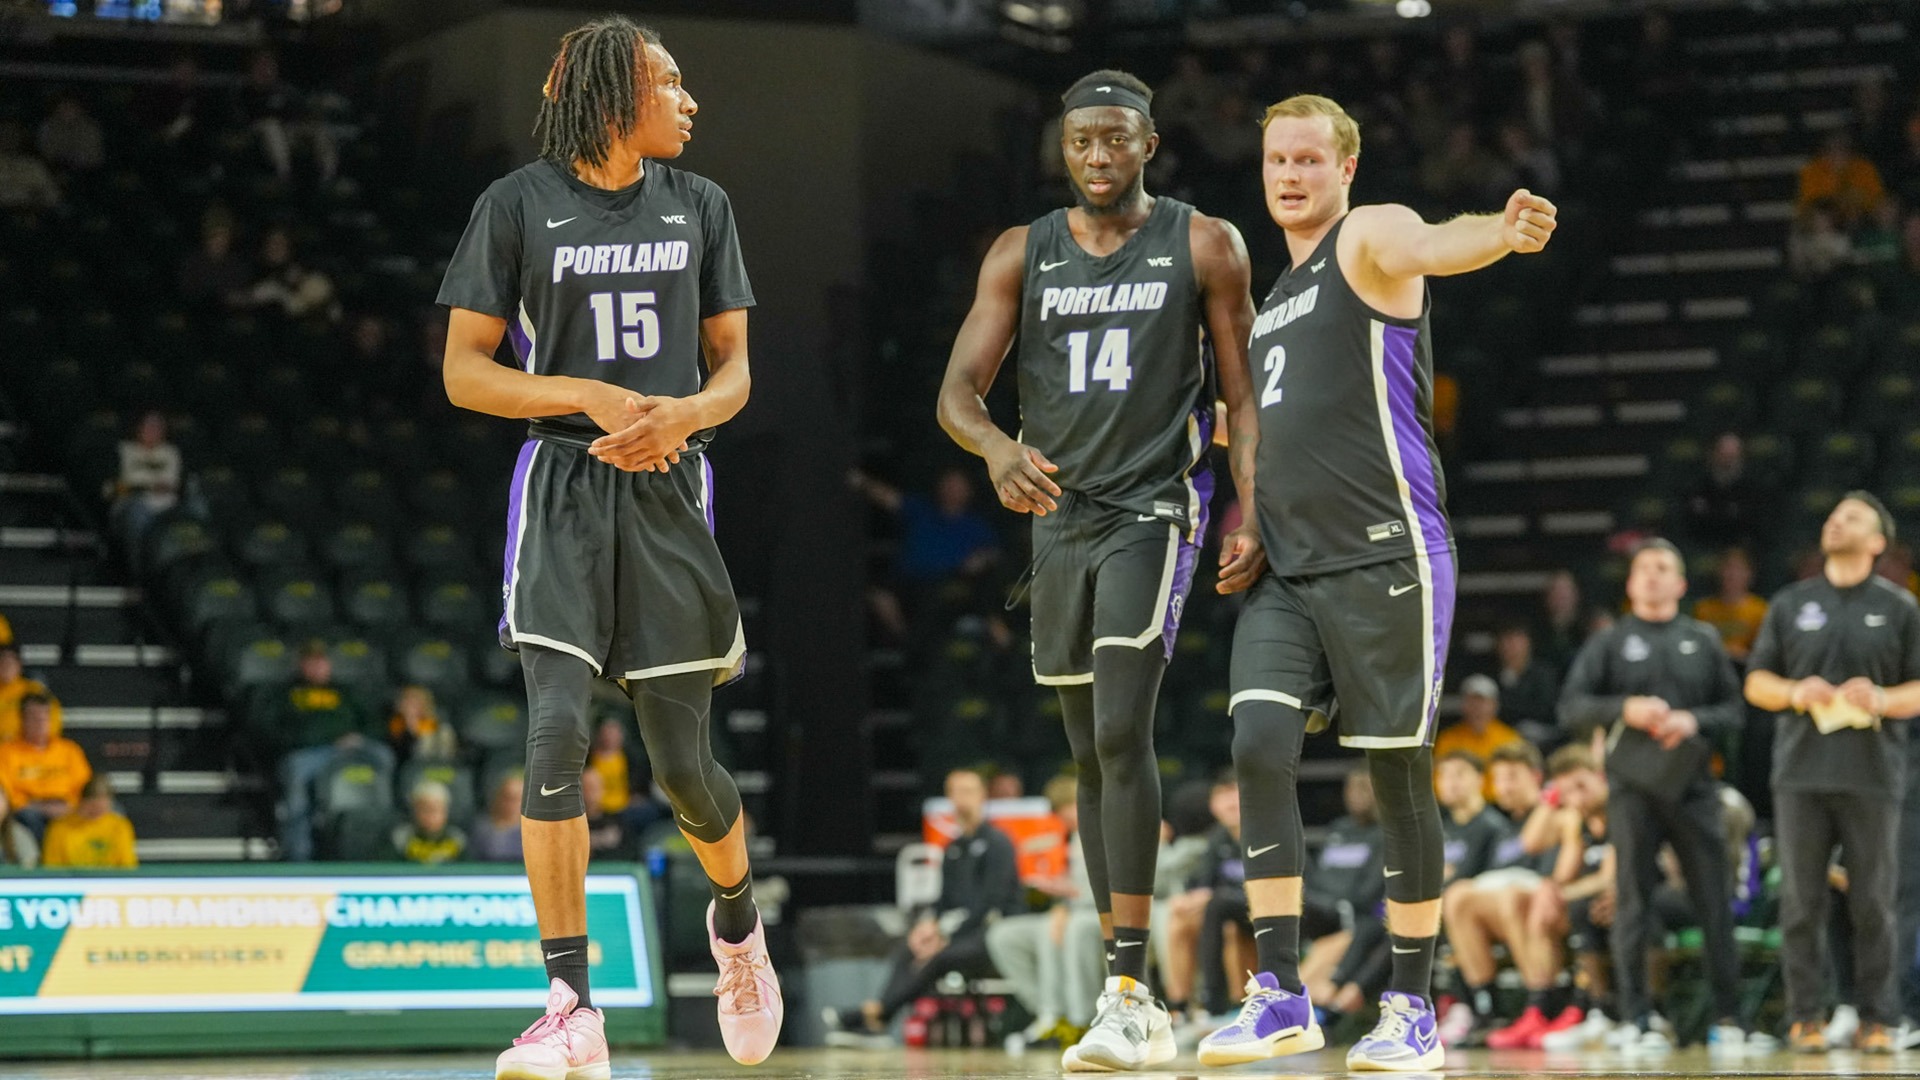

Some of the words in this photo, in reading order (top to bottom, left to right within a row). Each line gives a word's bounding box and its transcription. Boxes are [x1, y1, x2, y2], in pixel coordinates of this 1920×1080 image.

[660, 215, 687, 225] WCC
[552, 240, 689, 284] PORTLAND
[1040, 281, 1168, 321] PORTLAND
[589, 290, 661, 362] 15
[1067, 328, 1132, 393] 14
[1261, 344, 1287, 409] 2
[1390, 524, 1402, 533] XL
[15, 897, 121, 929] YOUR
[126, 897, 321, 928] BRANDING
[342, 940, 484, 969] GRAPHIC
